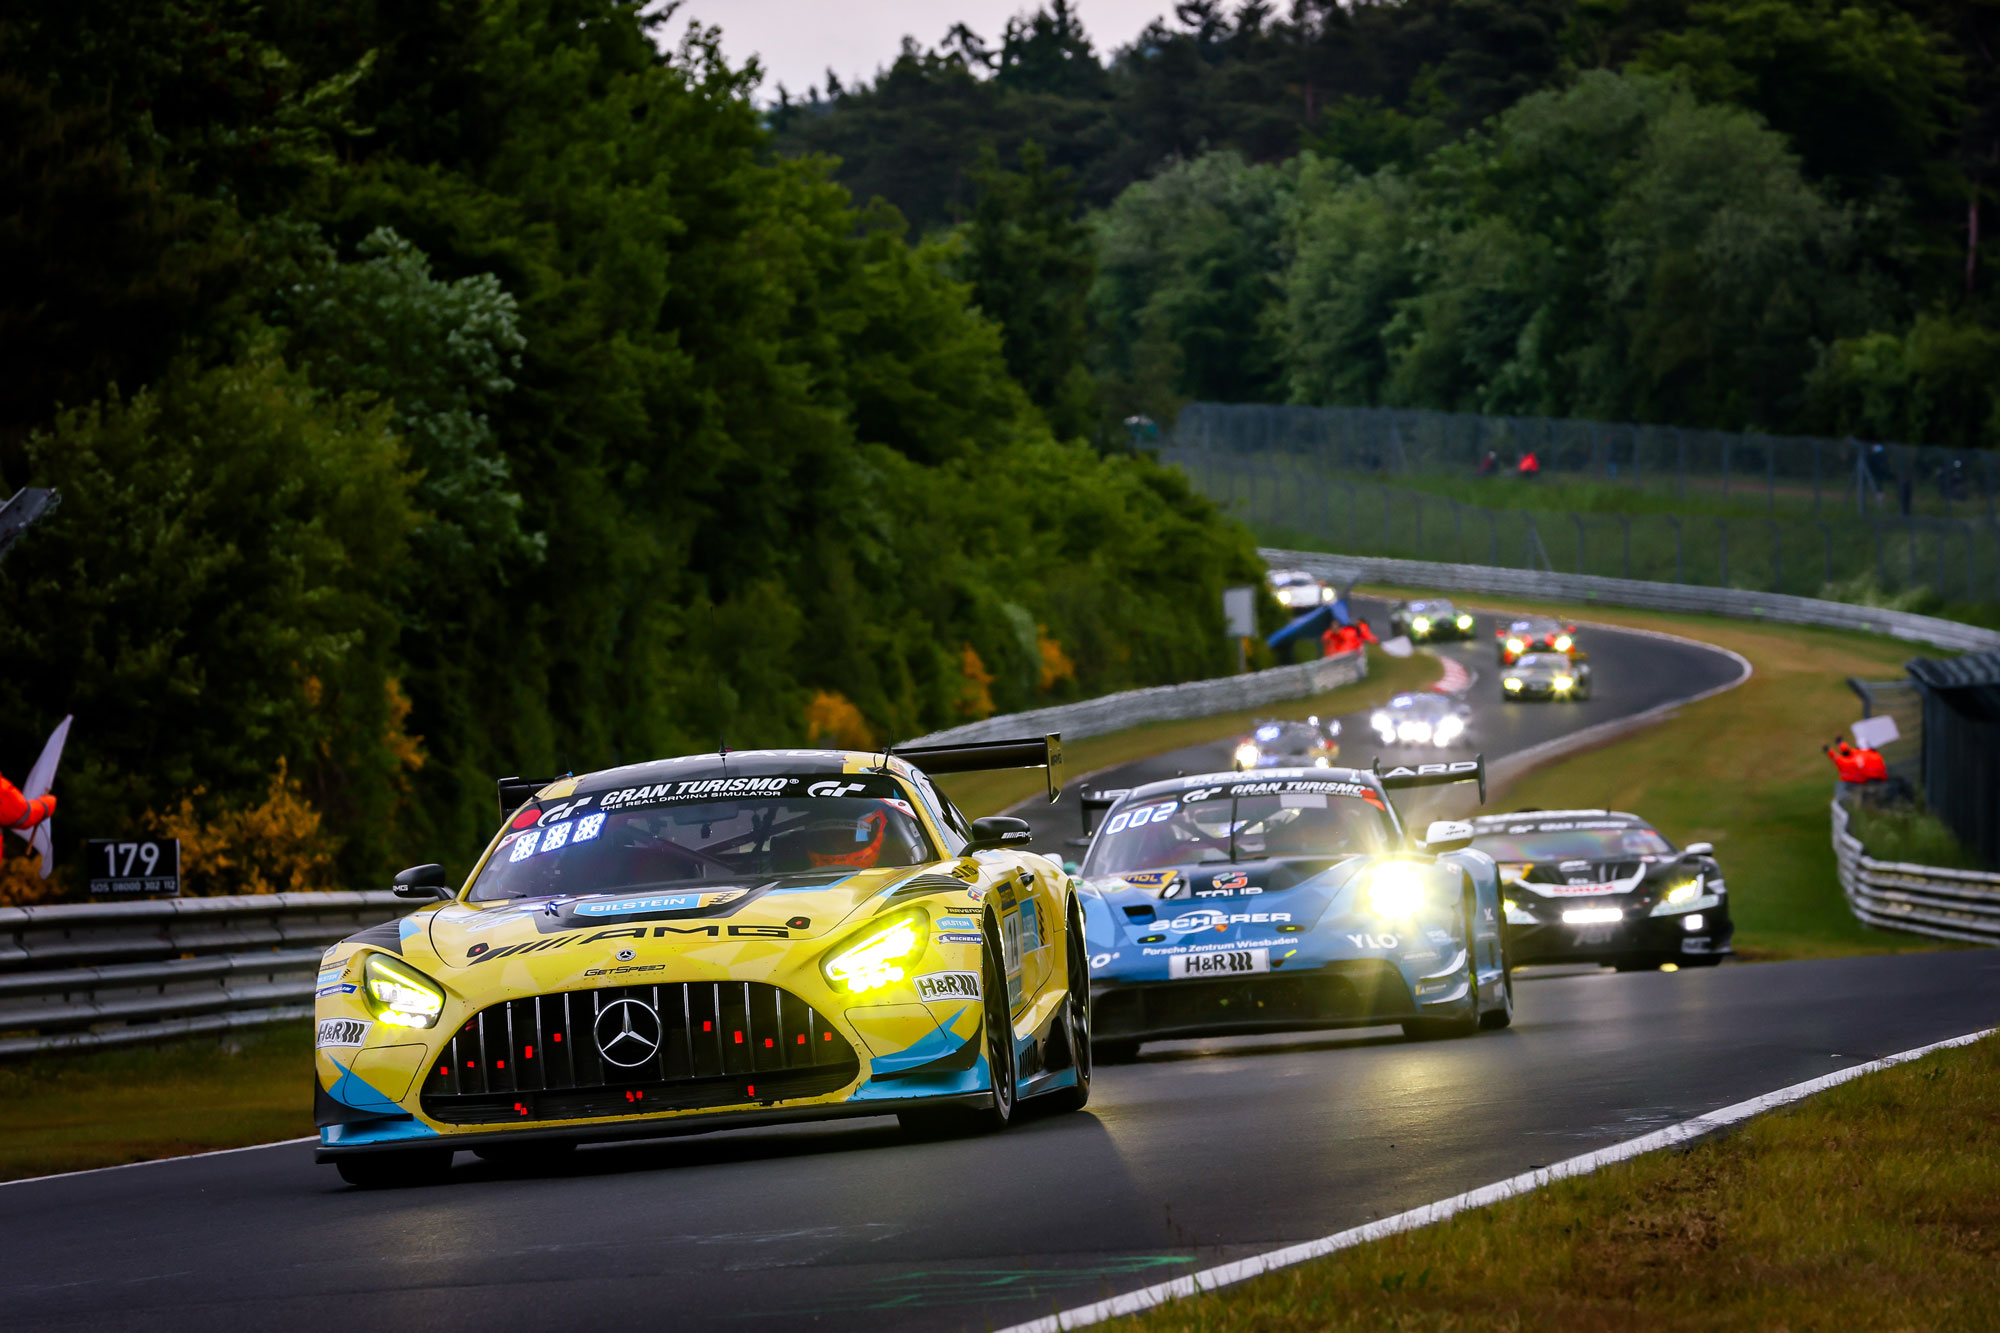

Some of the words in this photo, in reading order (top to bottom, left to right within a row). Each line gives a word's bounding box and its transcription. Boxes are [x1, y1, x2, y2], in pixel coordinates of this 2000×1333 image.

[600, 783, 672, 806] GRAN
[1230, 782, 1282, 795] GRAN
[600, 802, 623, 812] THE
[625, 797, 656, 808] REAL
[659, 793, 708, 803] DRIVING
[711, 791, 781, 799] SIMULATOR
[1105, 801, 1180, 835] 002
[104, 842, 159, 877] 179
[590, 897, 686, 912] BILSTEIN
[1149, 913, 1292, 932] SCHERER
[578, 925, 789, 944] AMG
[1142, 945, 1187, 956] Porsche
[1189, 942, 1234, 953] Zentrum
[1236, 937, 1299, 949] Wiesbaden
[1185, 954, 1226, 973] H&R
[918, 975, 959, 997] H&R
[317, 1021, 343, 1043] H&R
